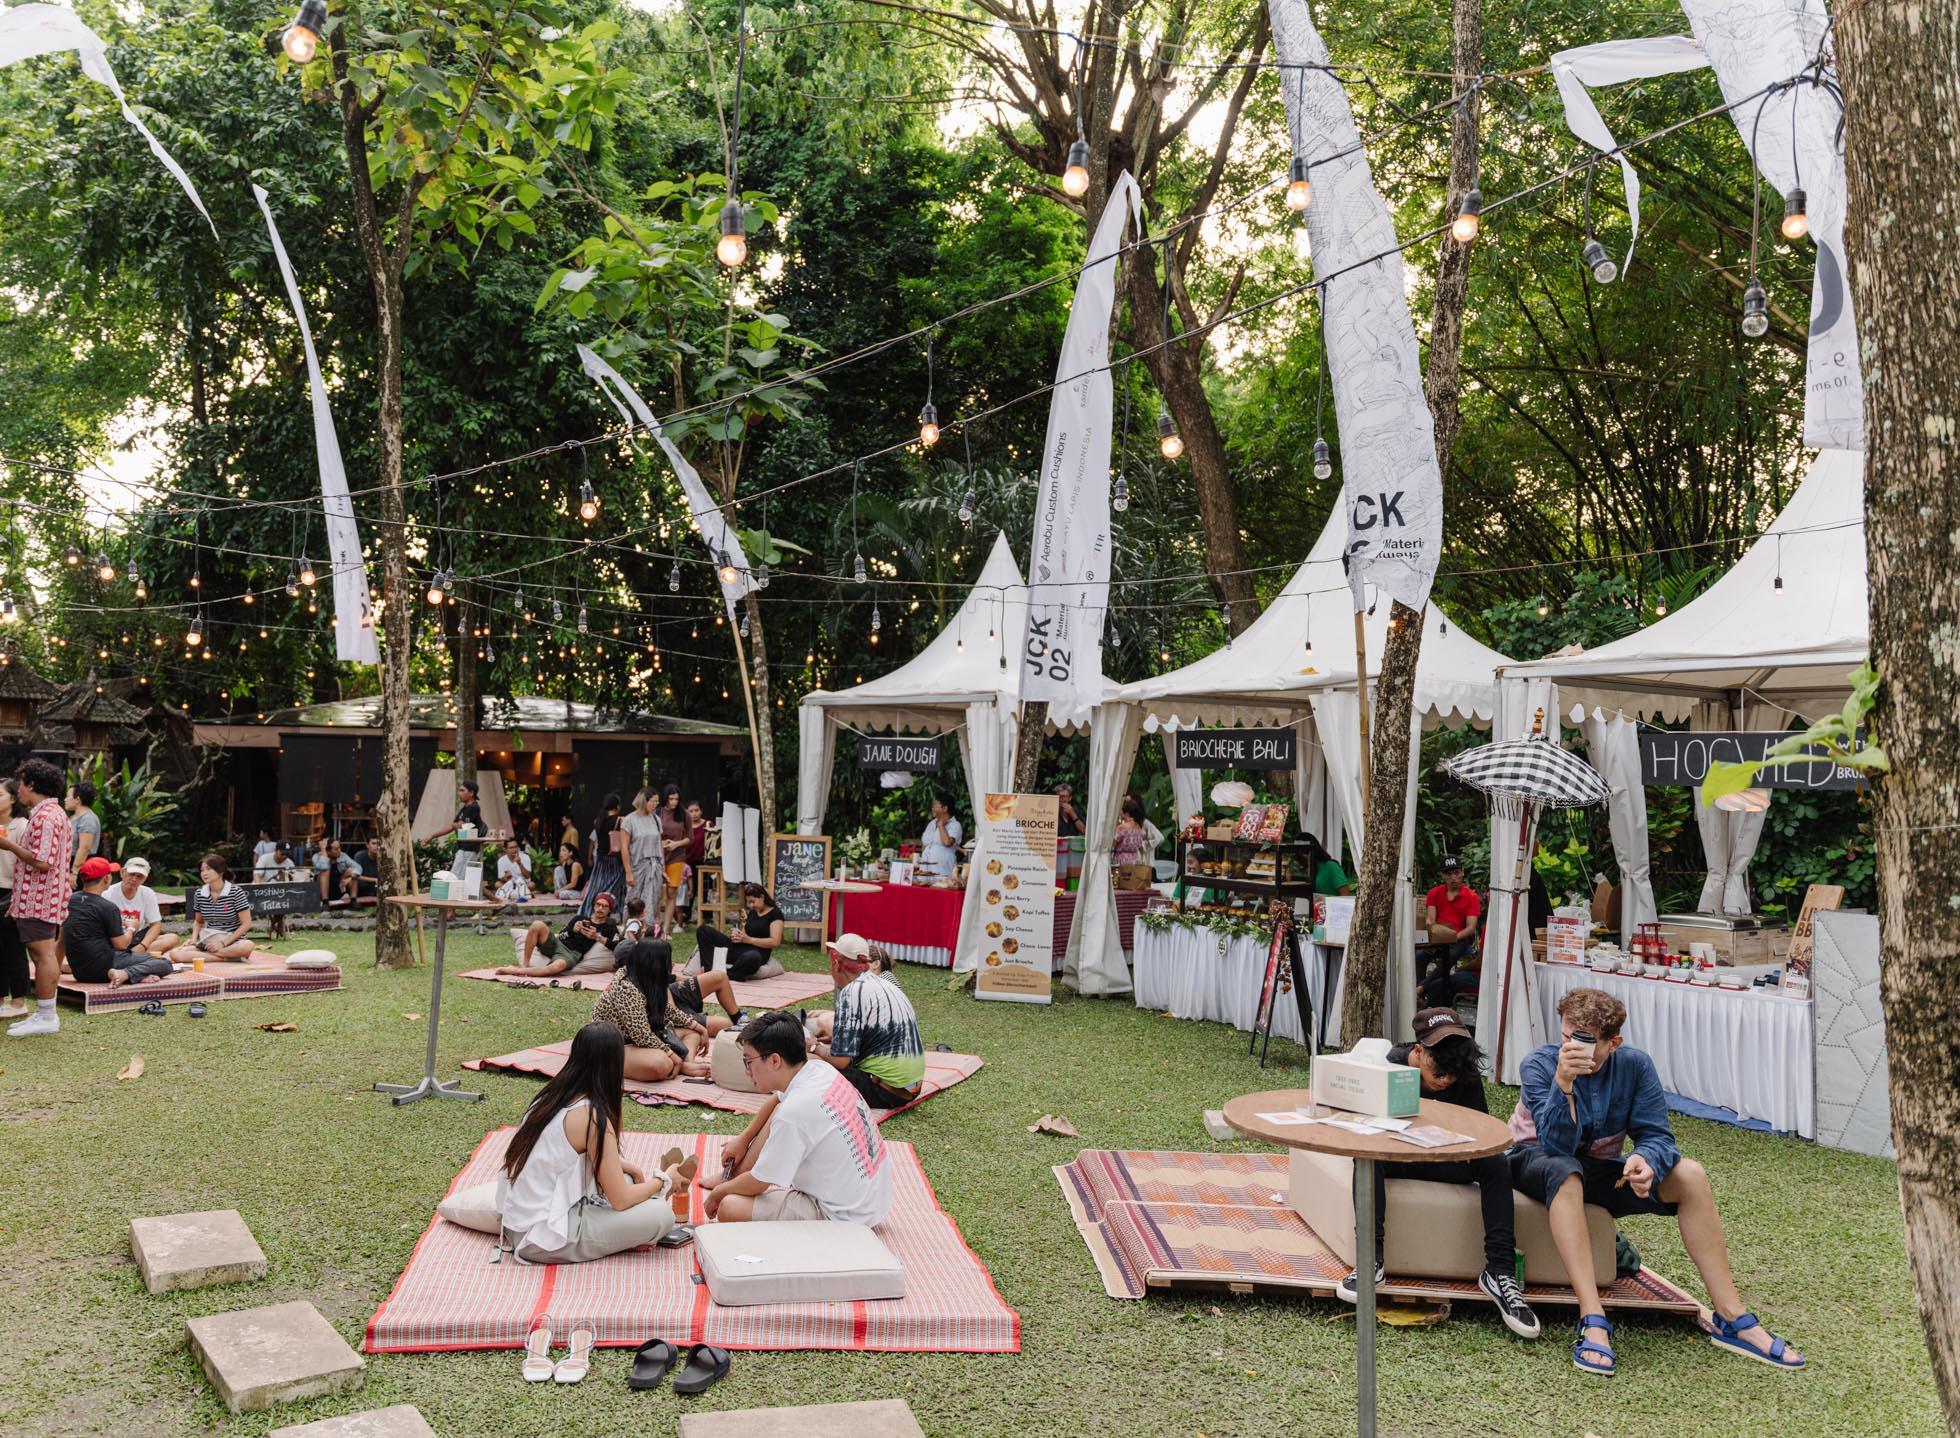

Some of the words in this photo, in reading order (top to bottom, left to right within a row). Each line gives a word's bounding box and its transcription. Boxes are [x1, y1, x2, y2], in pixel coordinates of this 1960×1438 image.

[1051, 431, 1067, 480] Cushions
[1076, 426, 1092, 481] INDONESIA
[1045, 481, 1059, 522] Custom
[1353, 491, 1406, 530] CK
[1041, 524, 1053, 562] Aerobu
[1026, 615, 1052, 676] JCK
[1049, 648, 1071, 682] 02
[863, 744, 892, 762] JANE
[896, 745, 937, 765] DOUGH
[1180, 739, 1245, 759] BRIOCHERIE
[1252, 740, 1289, 760] BALI
[1838, 740, 1867, 750] WT
[1015, 819, 1055, 829] BRIOCHE
